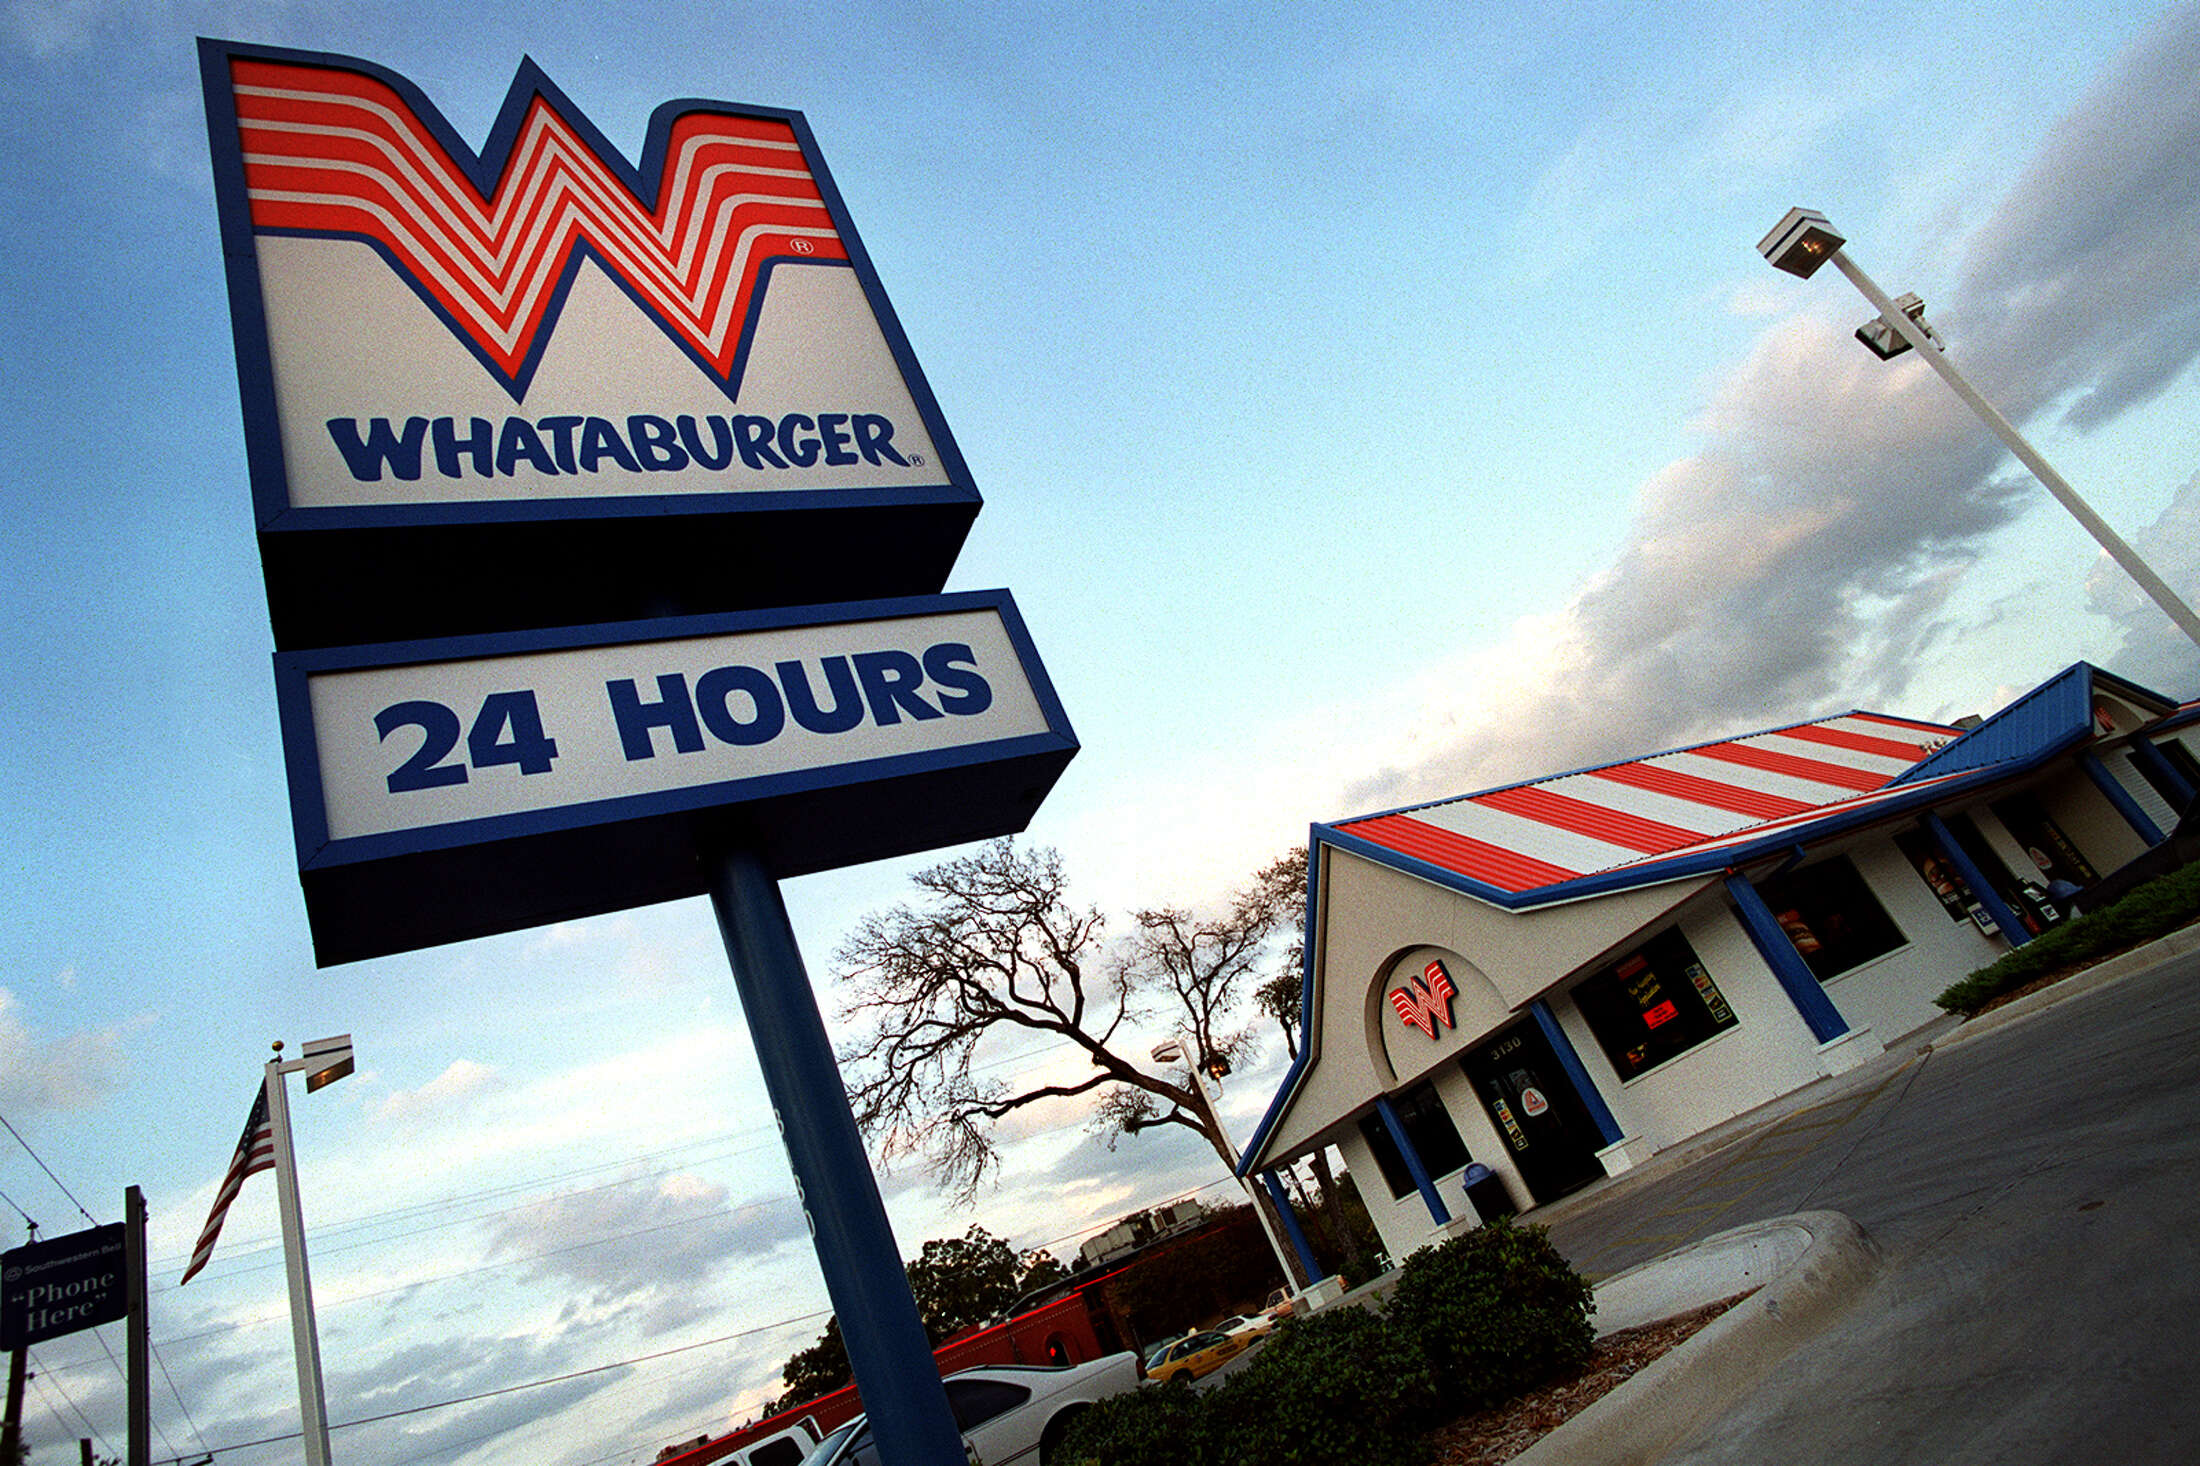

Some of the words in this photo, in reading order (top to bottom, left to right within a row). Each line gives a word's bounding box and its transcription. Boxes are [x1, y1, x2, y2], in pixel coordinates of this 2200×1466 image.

[326, 413, 912, 482] WHATABURGER
[372, 689, 560, 795] 24
[605, 642, 994, 762] HOURS
[1490, 1036, 1522, 1061] 3130
